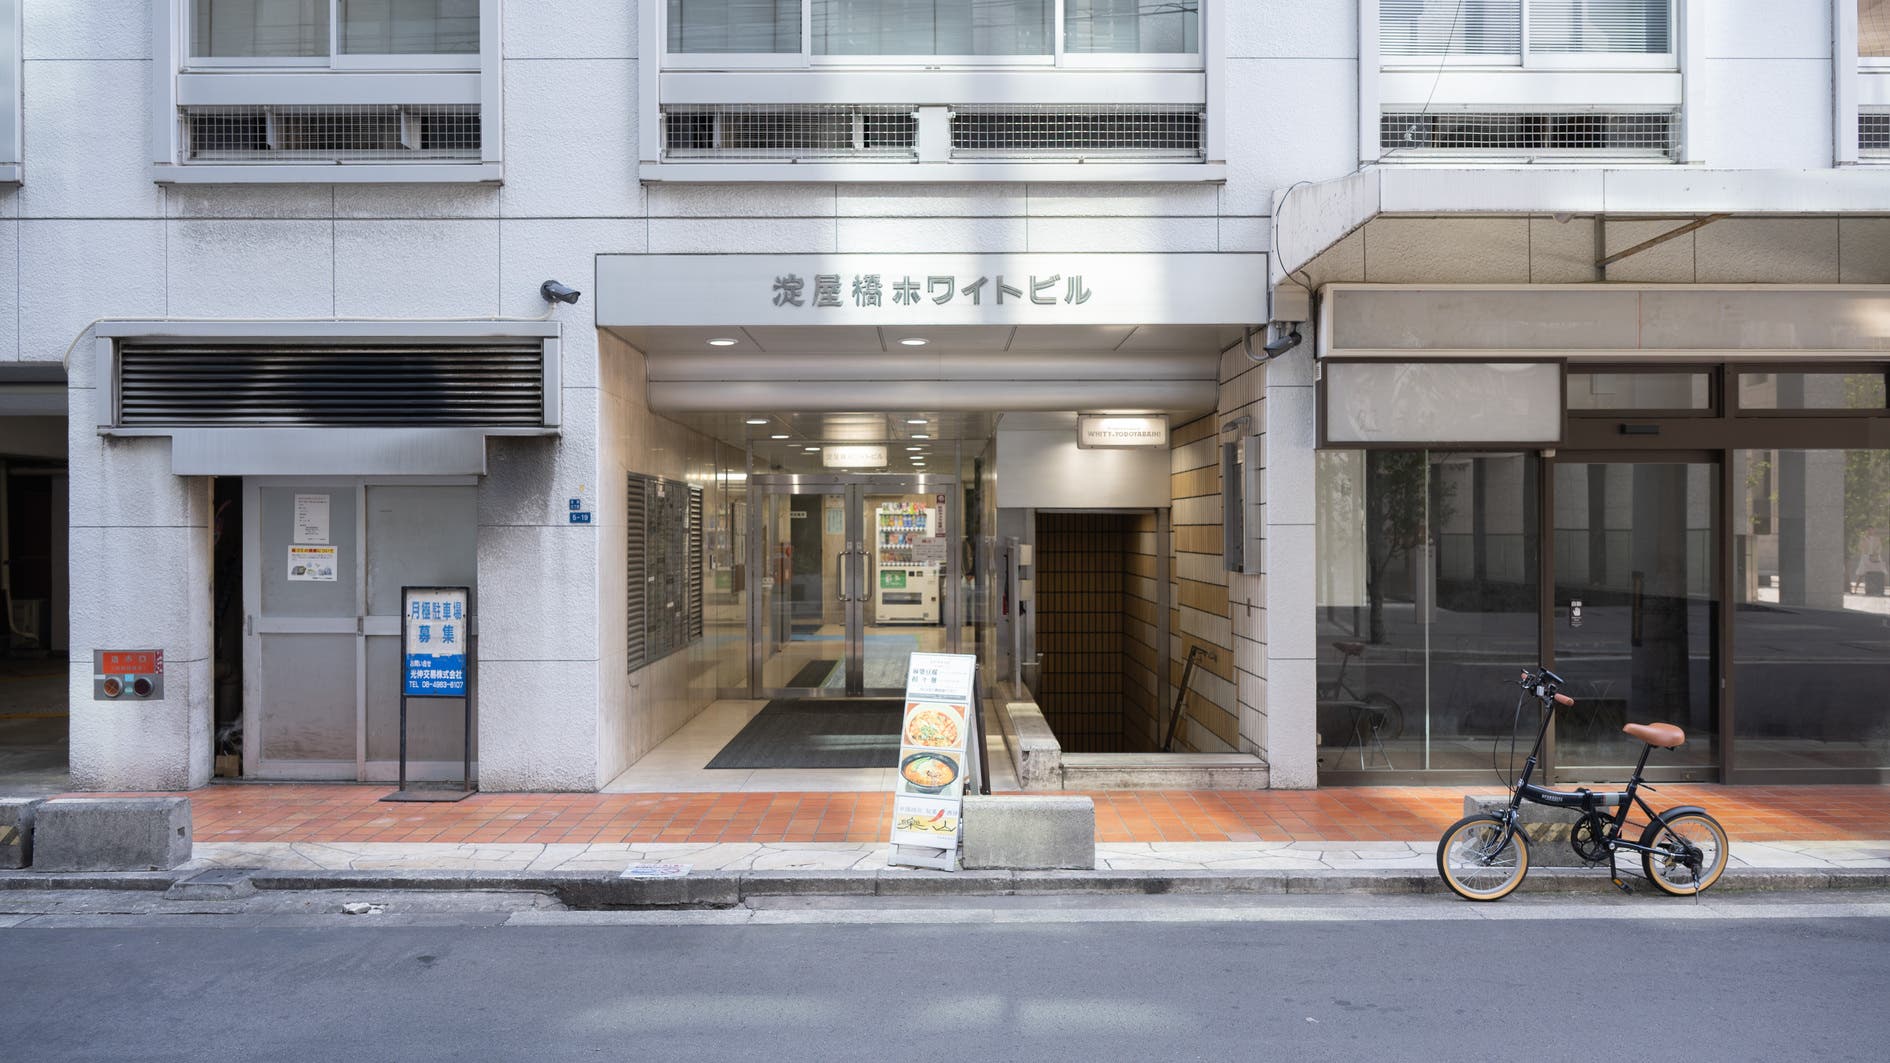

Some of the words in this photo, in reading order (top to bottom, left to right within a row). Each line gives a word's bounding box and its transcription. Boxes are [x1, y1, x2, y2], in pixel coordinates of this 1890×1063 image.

[772, 273, 1092, 308] 淀屋橋ホワイトビル
[412, 602, 462, 620] 月極駐車場
